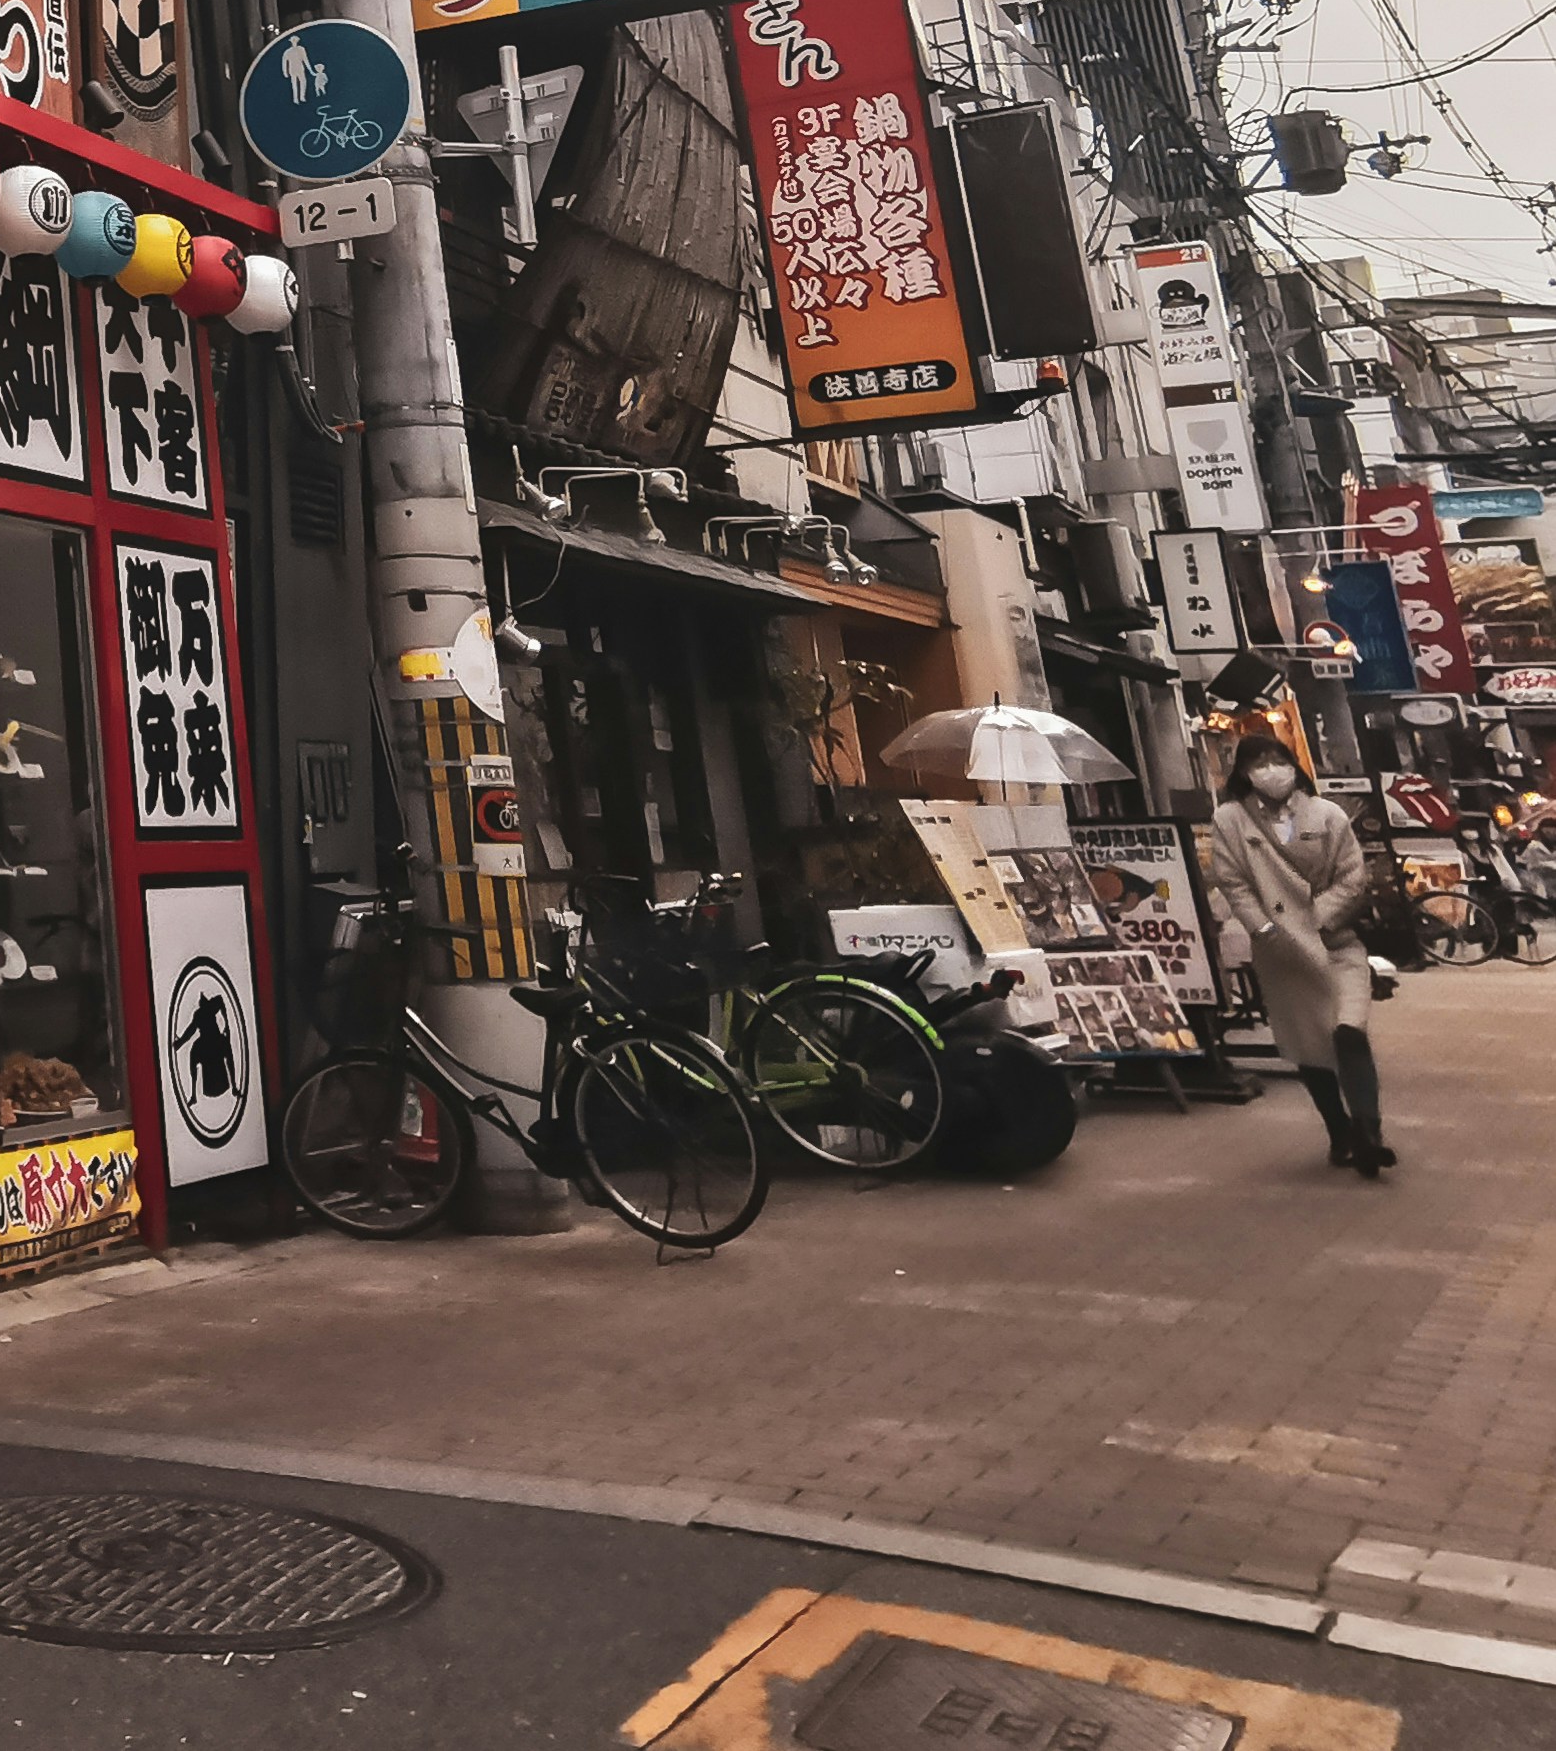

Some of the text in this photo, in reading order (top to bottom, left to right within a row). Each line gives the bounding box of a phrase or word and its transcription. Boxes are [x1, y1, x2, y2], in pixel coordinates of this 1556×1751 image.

[770, 207, 835, 347] 50人以上
[853, 93, 943, 302] 鍋物各種
[824, 365, 939, 399] 法善寺店
[1212, 387, 1232, 402] 1F
[1369, 500, 1454, 680] づぼらや
[125, 556, 187, 818] 御免
[172, 567, 231, 817] 万来
